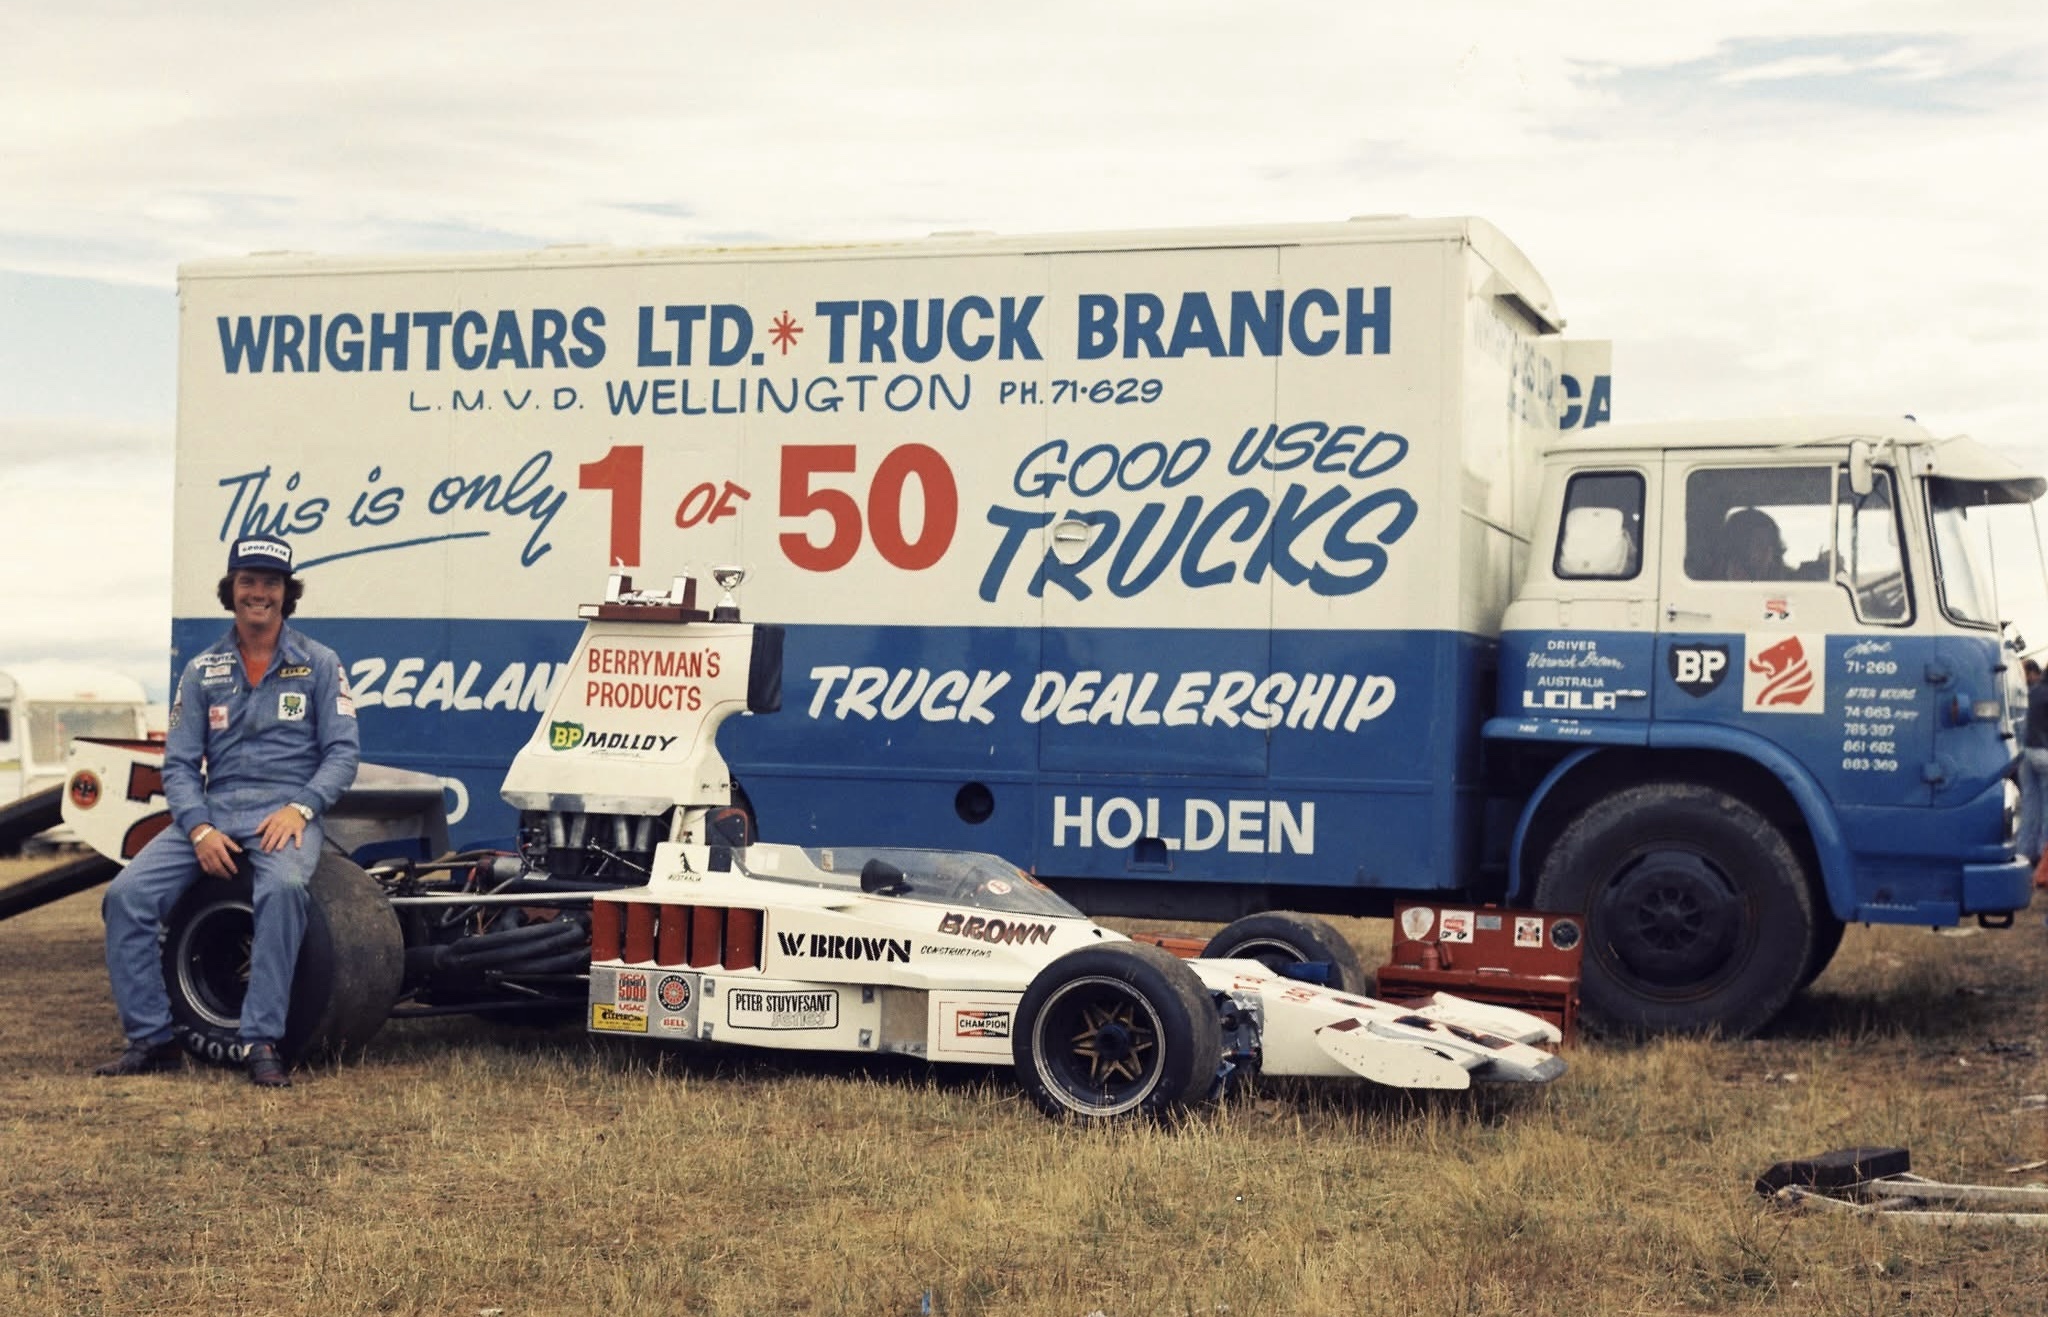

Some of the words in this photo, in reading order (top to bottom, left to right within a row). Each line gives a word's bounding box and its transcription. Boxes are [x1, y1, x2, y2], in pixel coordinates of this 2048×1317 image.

[217, 306, 607, 374] WRIGHTCARS
[637, 304, 765, 367] LTD.
[816, 295, 1045, 364] TRUCK
[1077, 286, 1392, 360] BRANCH
[606, 374, 971, 415] WELLINGTON
[1013, 437, 1212, 499] GOOD
[1227, 421, 1409, 480] USED
[218, 465, 330, 541] This
[347, 466, 404, 527] is
[428, 450, 568, 567] only
[577, 445, 644, 567] 1
[675, 480, 751, 530] OF
[778, 443, 959, 573] 50
[978, 483, 1419, 603] TRUCKS
[1547, 640, 1597, 651] DRIVER
[587, 648, 721, 680] BERRYMAN'S
[1675, 650, 1727, 683] BP
[350, 658, 568, 712] ZEALAN
[586, 681, 702, 712] PRODUCTS
[1537, 676, 1605, 688] AUSTRALIA
[808, 665, 1011, 726] TRUCK
[1020, 670, 1398, 733] DEALERSHIP
[1522, 690, 1616, 710] LOLA
[552, 727, 582, 747] BP
[582, 731, 679, 752] MOLLOY
[1053, 796, 1316, 855] HOLDEN
[937, 911, 1057, 946] BROWN
[809, 934, 912, 963] BROWN
[920, 945, 992, 958] CONSTRUCTIONS
[618, 987, 647, 998] 5000
[619, 1003, 645, 1011] USAC
[735, 993, 762, 1012] PETER
[766, 994, 832, 1012] STUYVESANT
[663, 1018, 686, 1027] BELL
[959, 1019, 1007, 1029] CHAMPION
